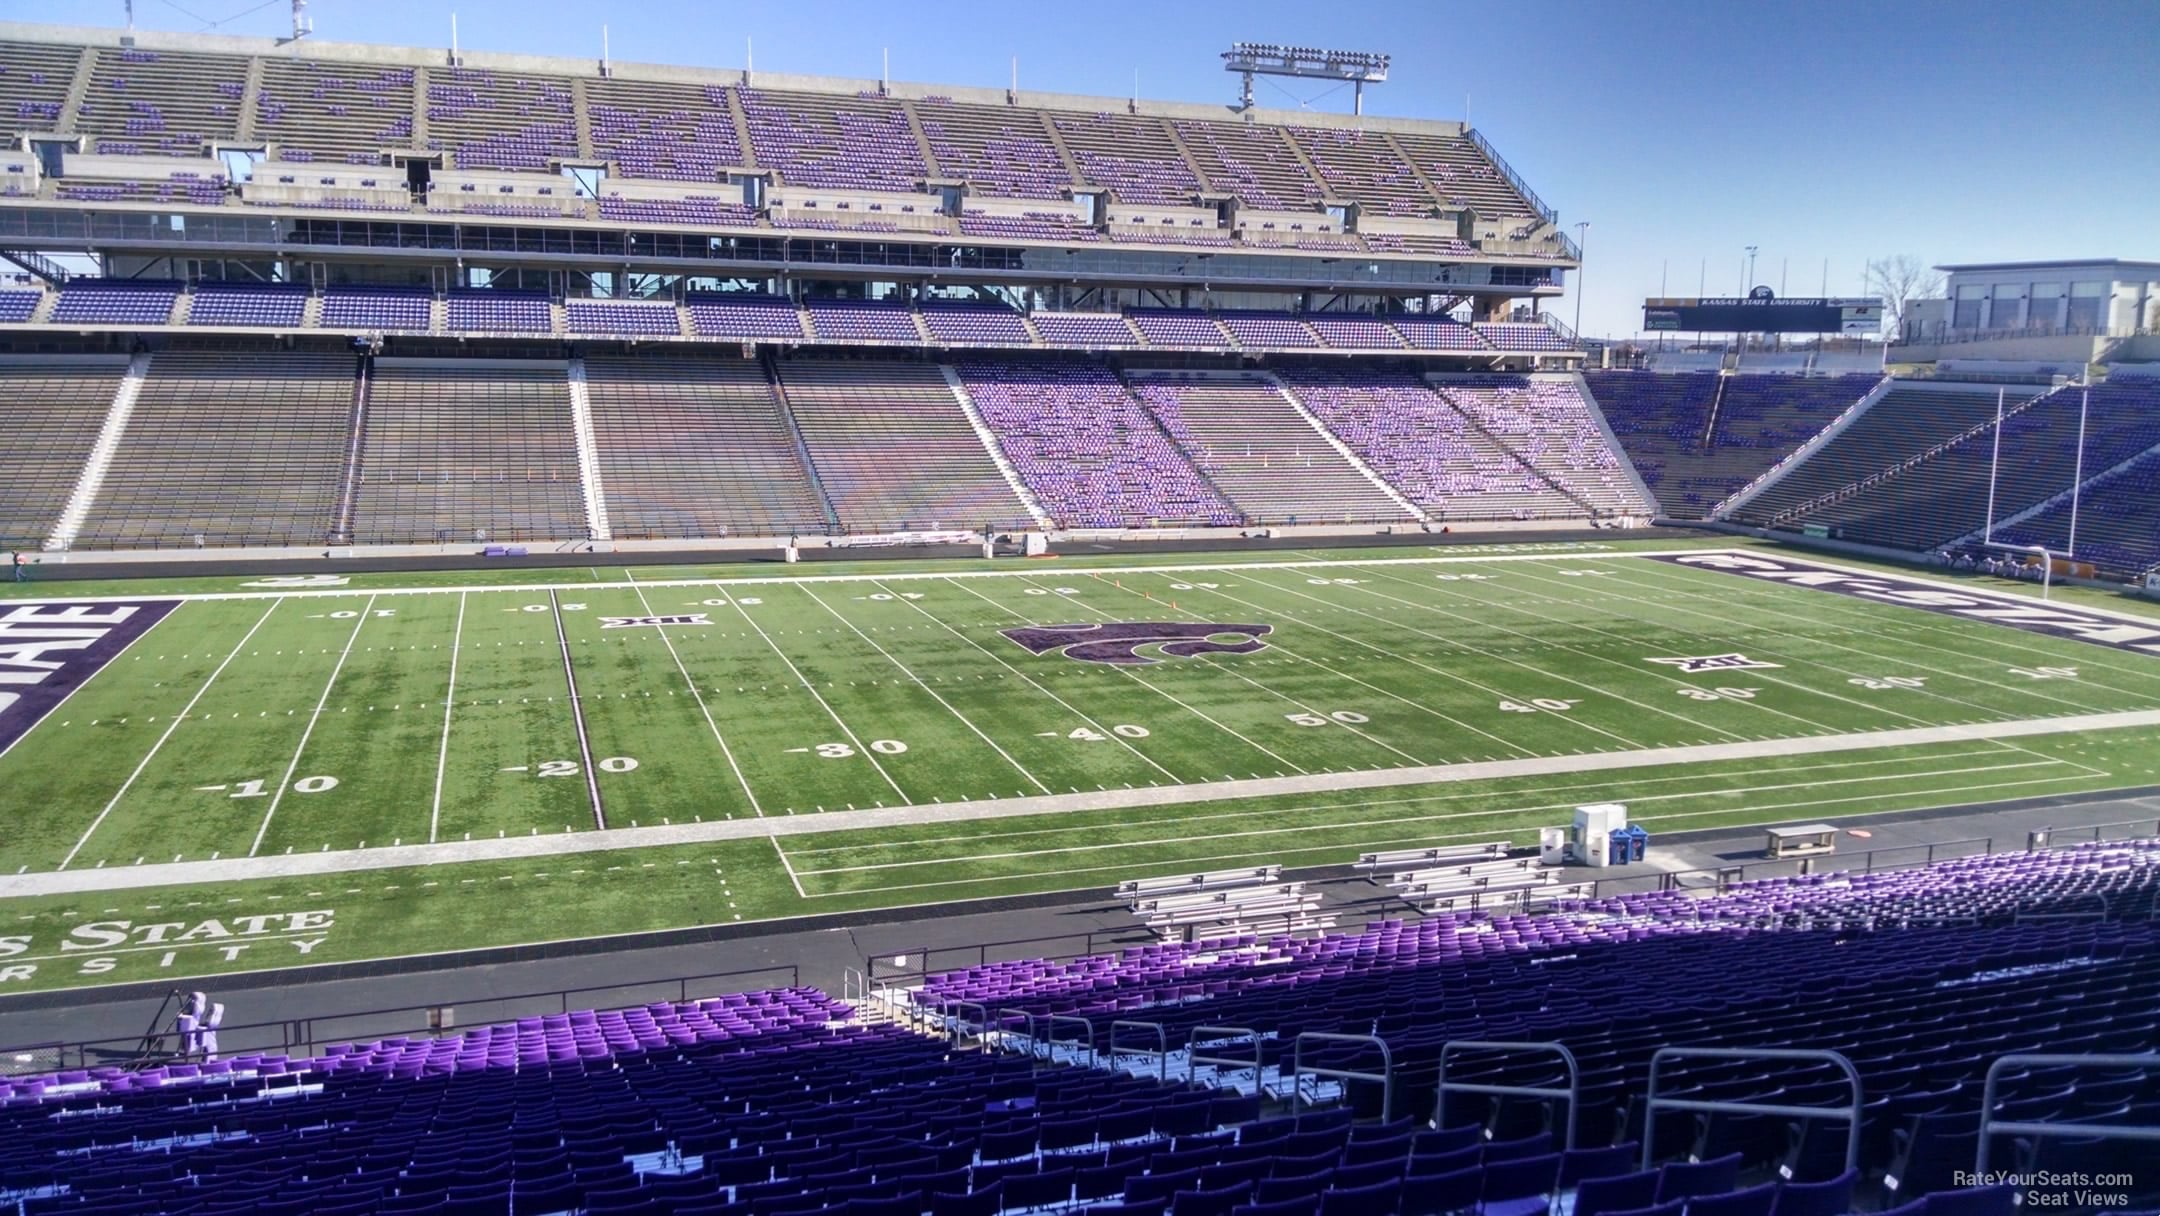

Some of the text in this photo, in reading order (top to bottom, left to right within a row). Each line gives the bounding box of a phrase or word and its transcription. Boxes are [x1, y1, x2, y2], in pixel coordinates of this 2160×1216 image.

[1499, 698, 1572, 713] 40
[1284, 711, 1370, 727] 50
[1068, 724, 1151, 742] 40
[815, 739, 908, 758] 30
[537, 756, 639, 778] 20
[229, 776, 339, 798] 10
